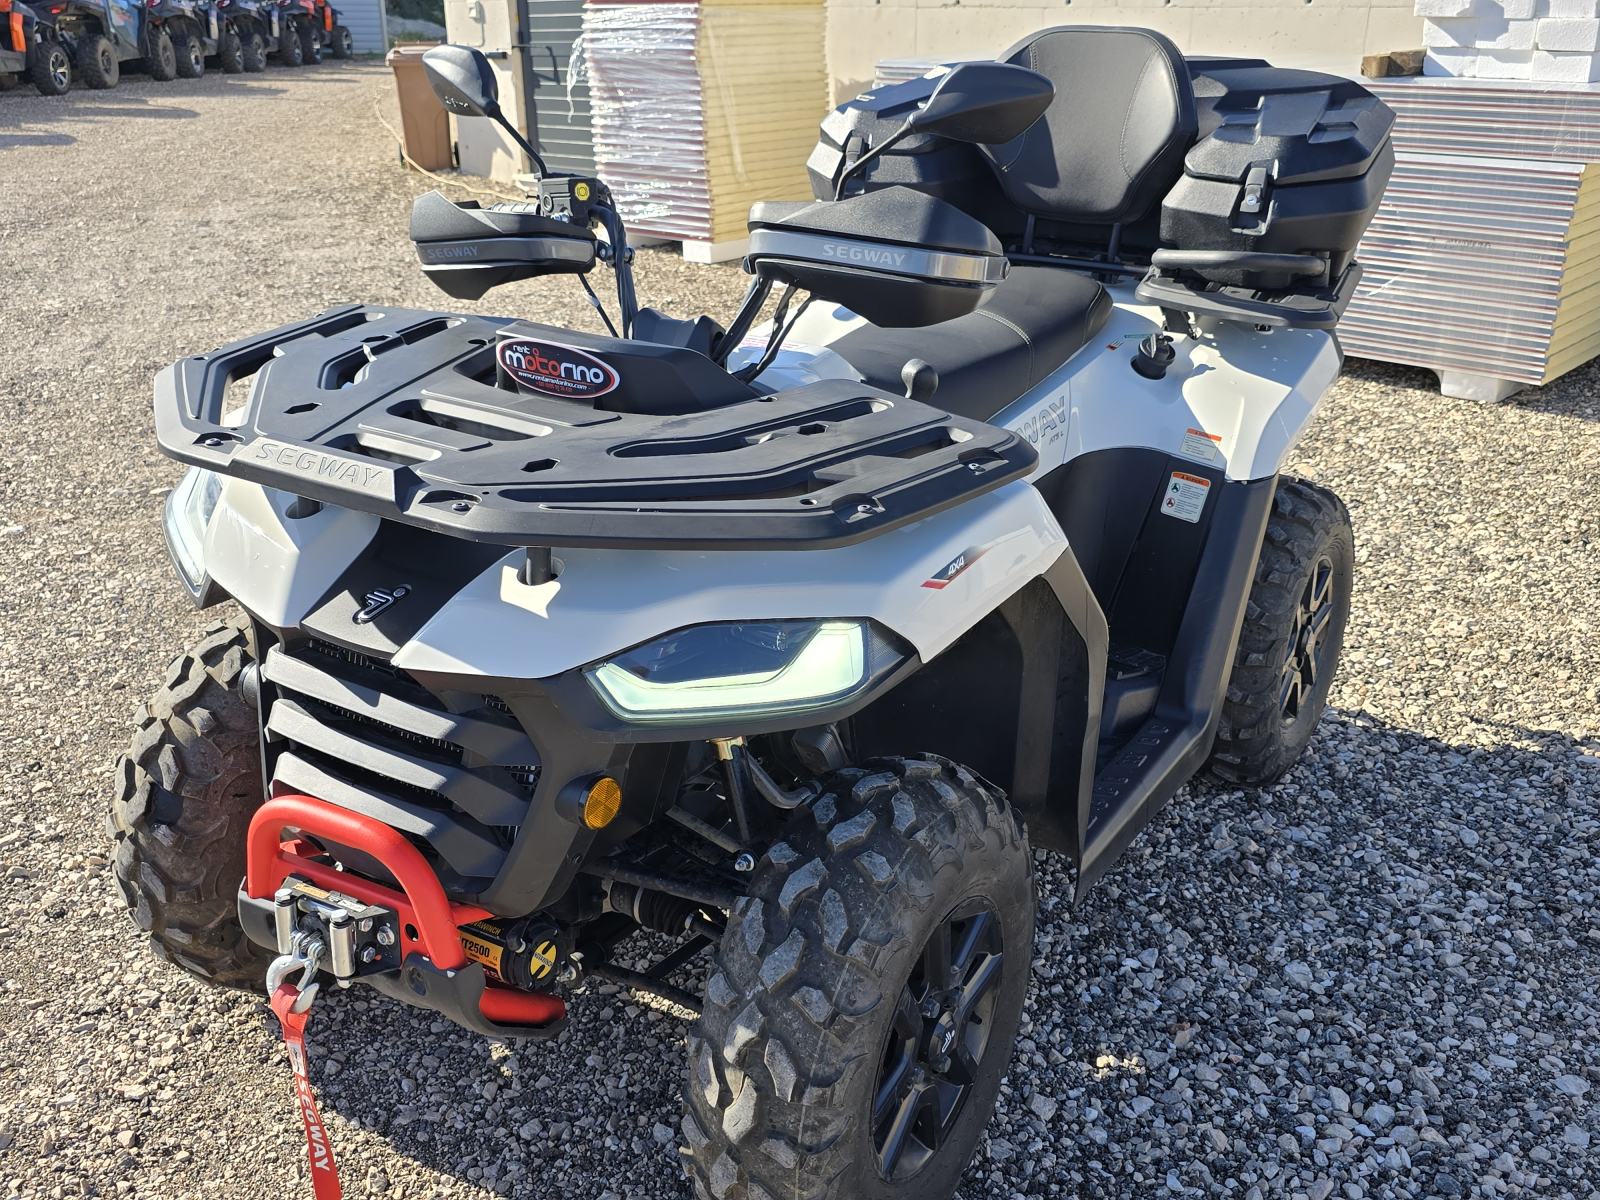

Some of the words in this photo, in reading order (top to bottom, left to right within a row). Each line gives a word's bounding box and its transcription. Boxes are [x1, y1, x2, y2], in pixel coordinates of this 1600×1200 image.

[426, 245, 479, 258] SEGWAY
[822, 243, 906, 266] SEGWAY
[513, 344, 531, 355] rent
[256, 443, 383, 487] SEGWAY
[299, 1079, 330, 1171] SEGWAY
